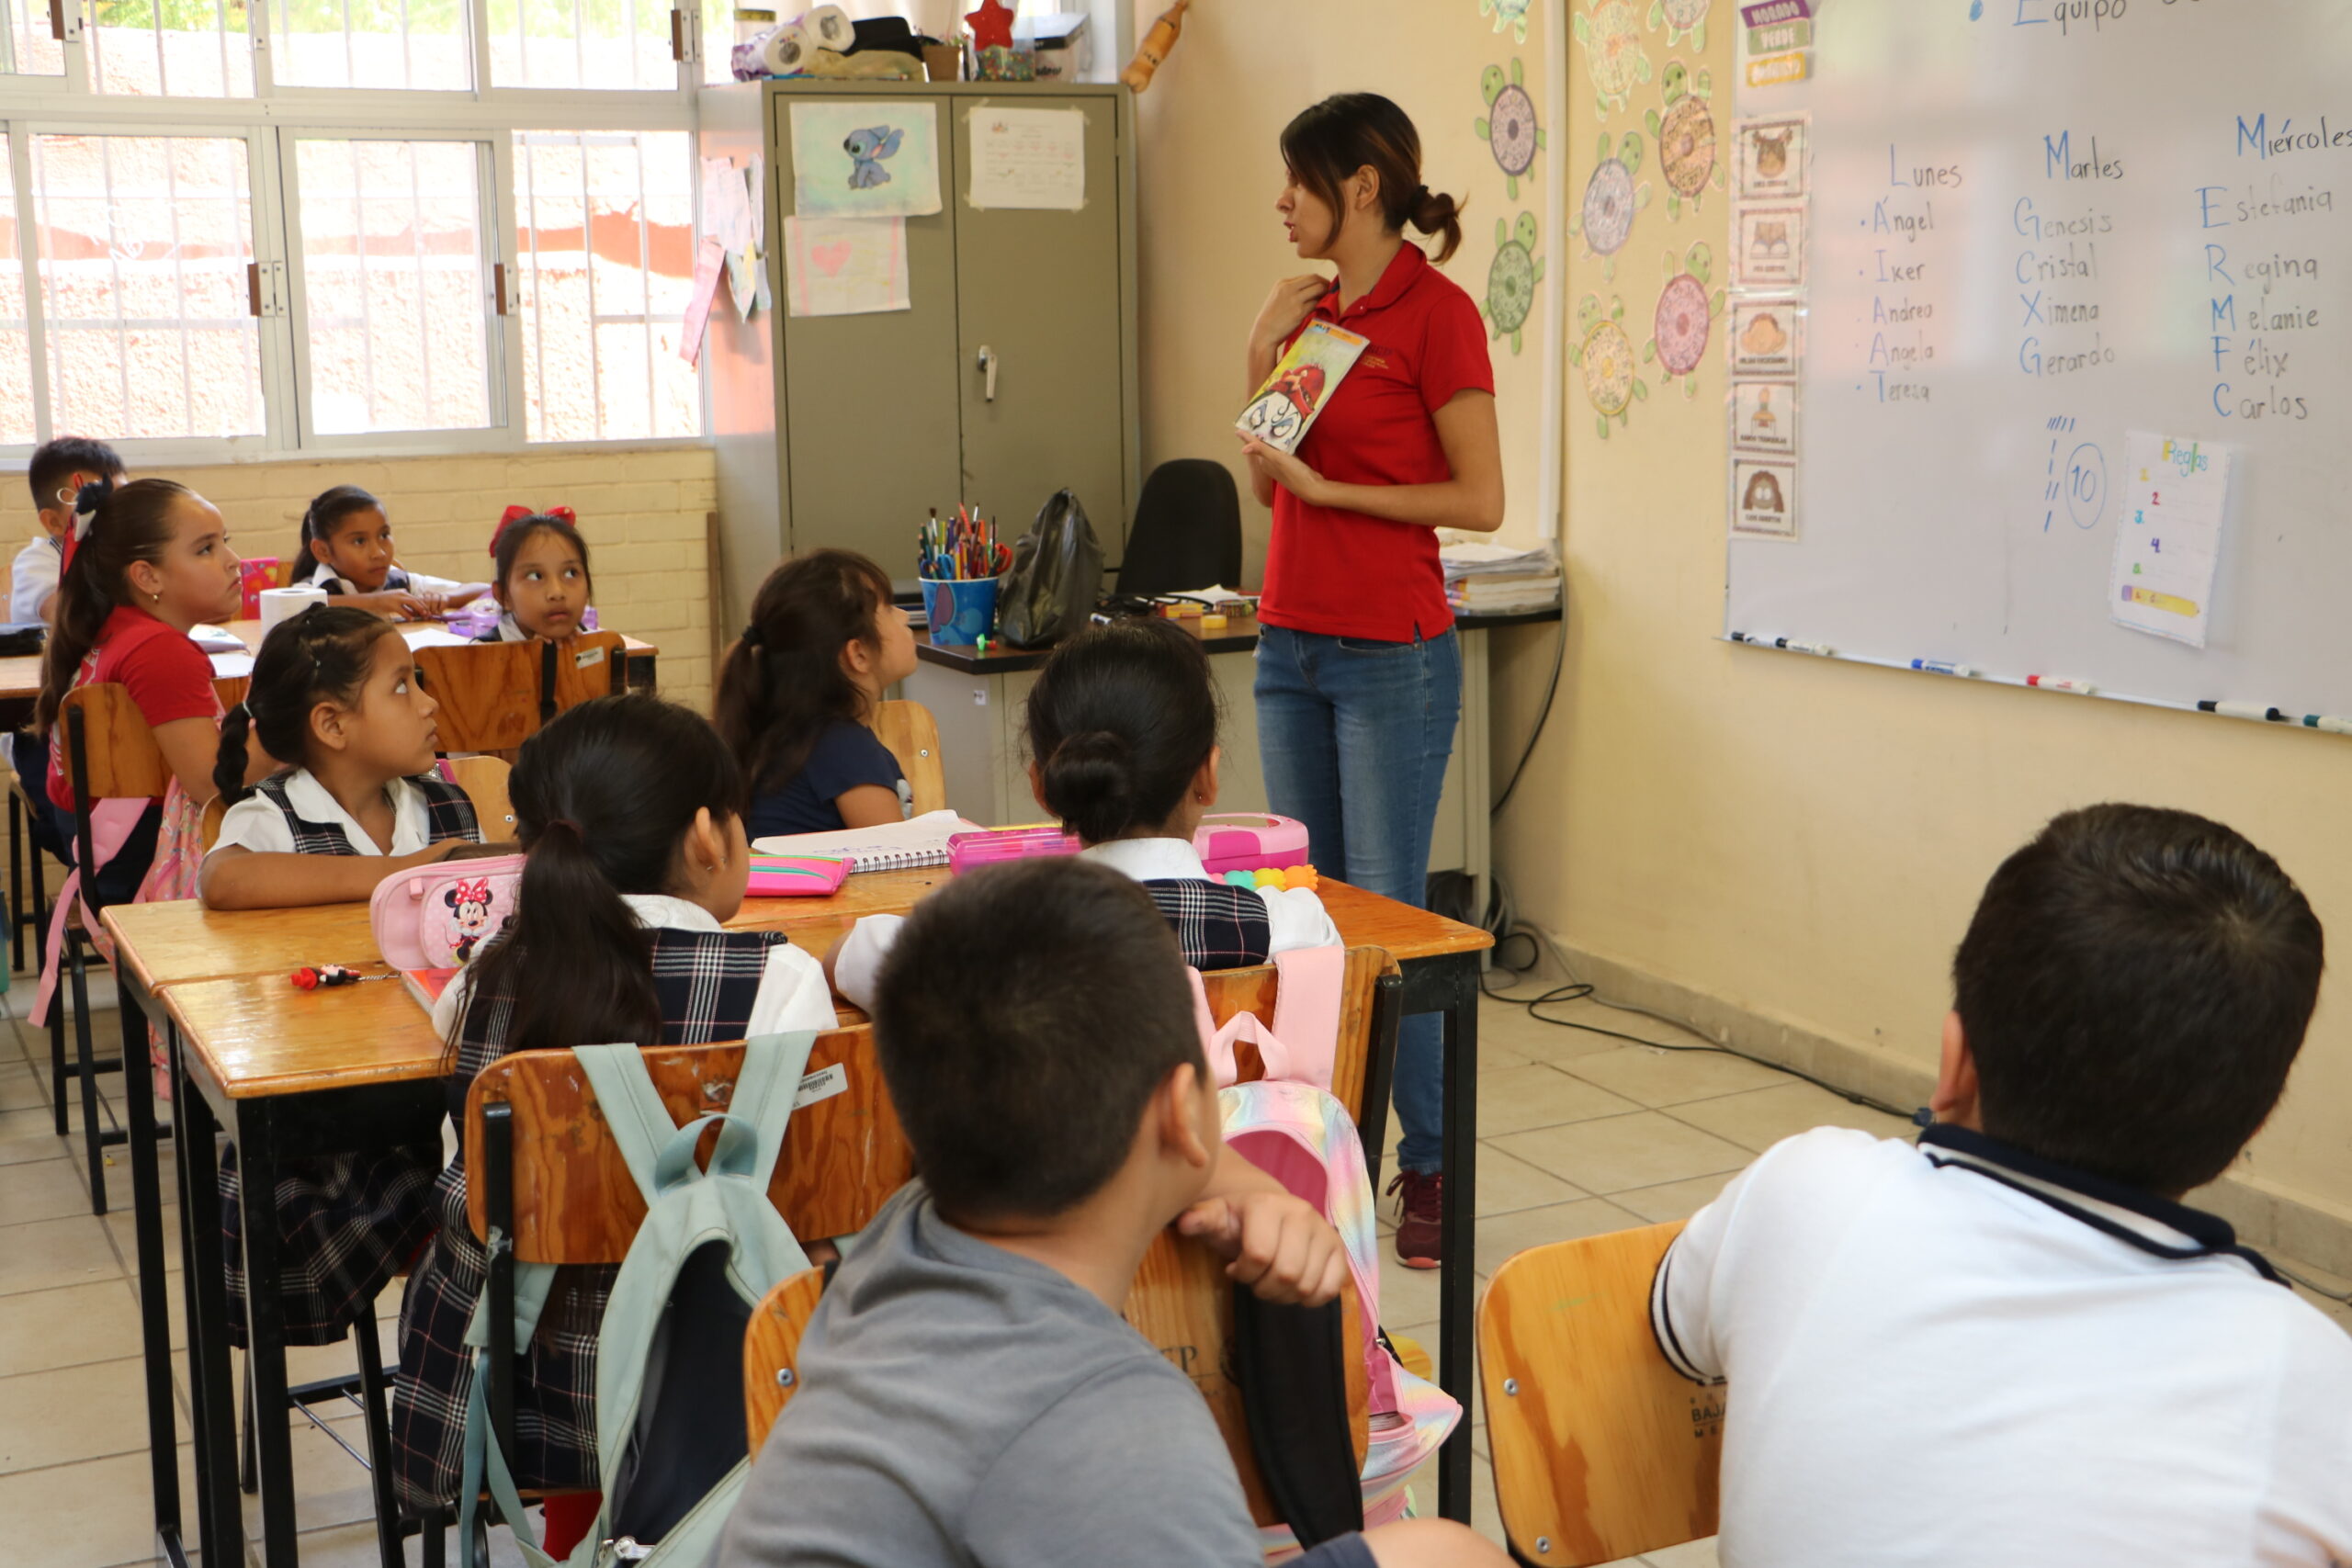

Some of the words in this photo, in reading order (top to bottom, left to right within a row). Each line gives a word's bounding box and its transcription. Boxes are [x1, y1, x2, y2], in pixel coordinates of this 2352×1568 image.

[2043, 130, 2123, 180] Martes
[2236, 113, 2352, 160] Miércoles
[1890, 143, 1962, 188] Lunes
[2014, 197, 2112, 242] Genesis
[1874, 249, 1926, 283] Iker
[2016, 242, 2098, 284] Cristal
[2204, 243, 2318, 294] Regina
[1872, 295, 1933, 324] Andrea
[2019, 290, 2099, 327] Ximena
[2211, 293, 2319, 332] Melanie
[2019, 332, 2115, 378] Gerardo
[2211, 335, 2289, 378] Félix
[2213, 383, 2308, 420] Carlos
[2161, 439, 2209, 478] Reglas
[2071, 465, 2097, 502] 10
[2150, 537, 2161, 553] 4
